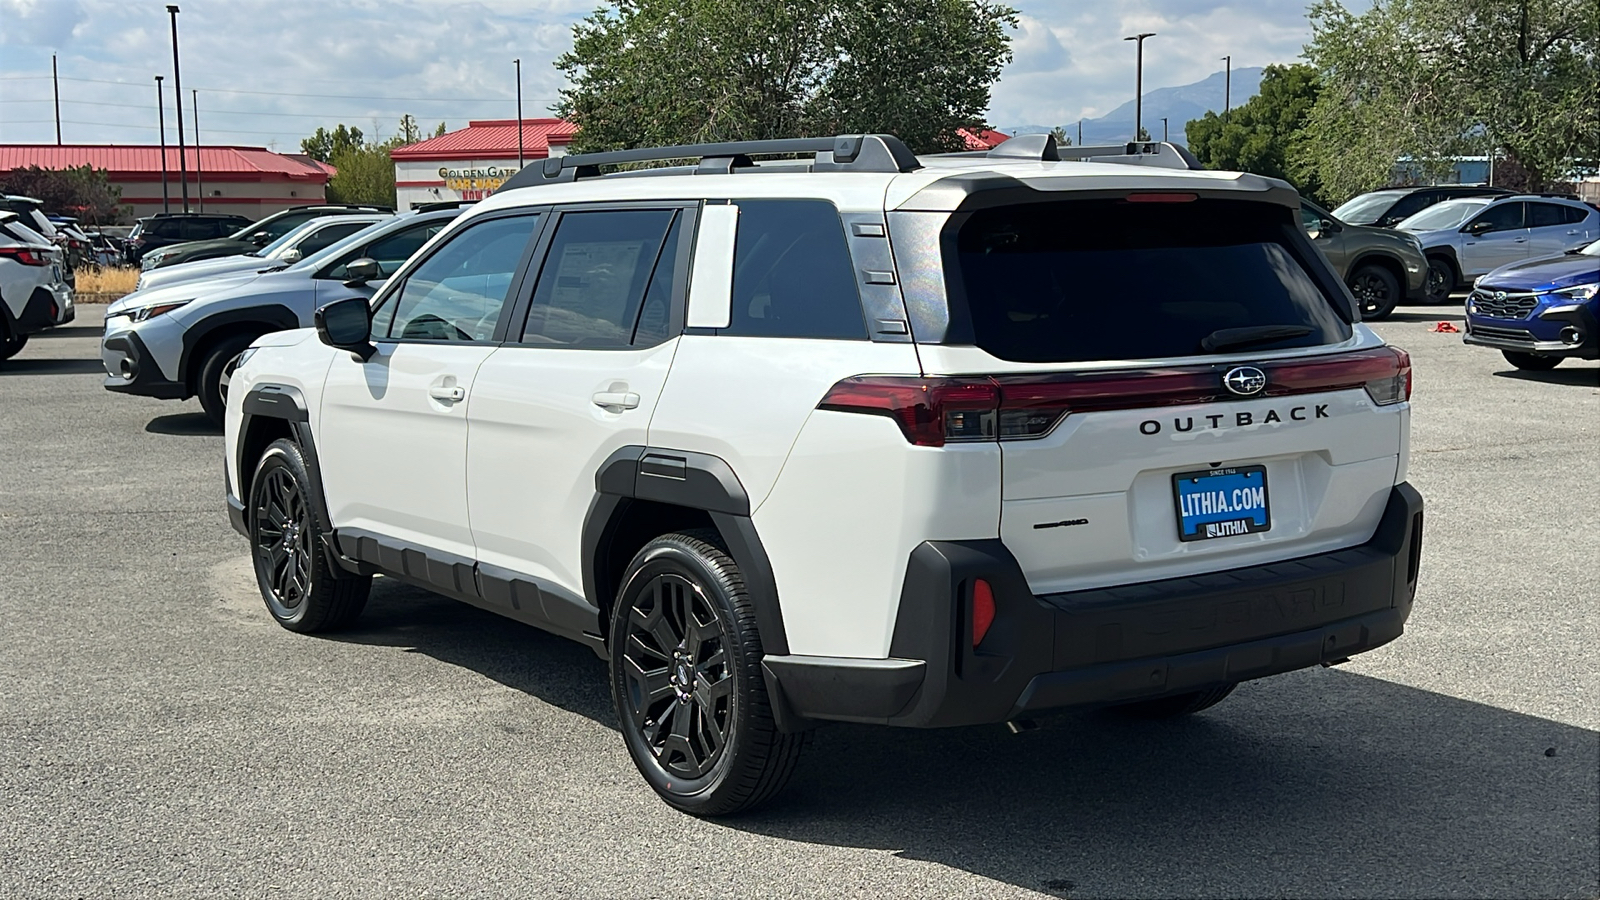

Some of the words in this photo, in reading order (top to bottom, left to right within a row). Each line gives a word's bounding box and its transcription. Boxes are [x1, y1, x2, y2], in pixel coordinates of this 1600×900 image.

[439, 167, 485, 178] GOLDEN
[487, 166, 517, 177] GATE
[447, 178, 472, 190] CAR
[462, 190, 483, 201] NOW
[1139, 404, 1330, 435] OUTBACK
[1180, 487, 1265, 517] LITHIA.COM
[1216, 520, 1249, 537] LITHIA
